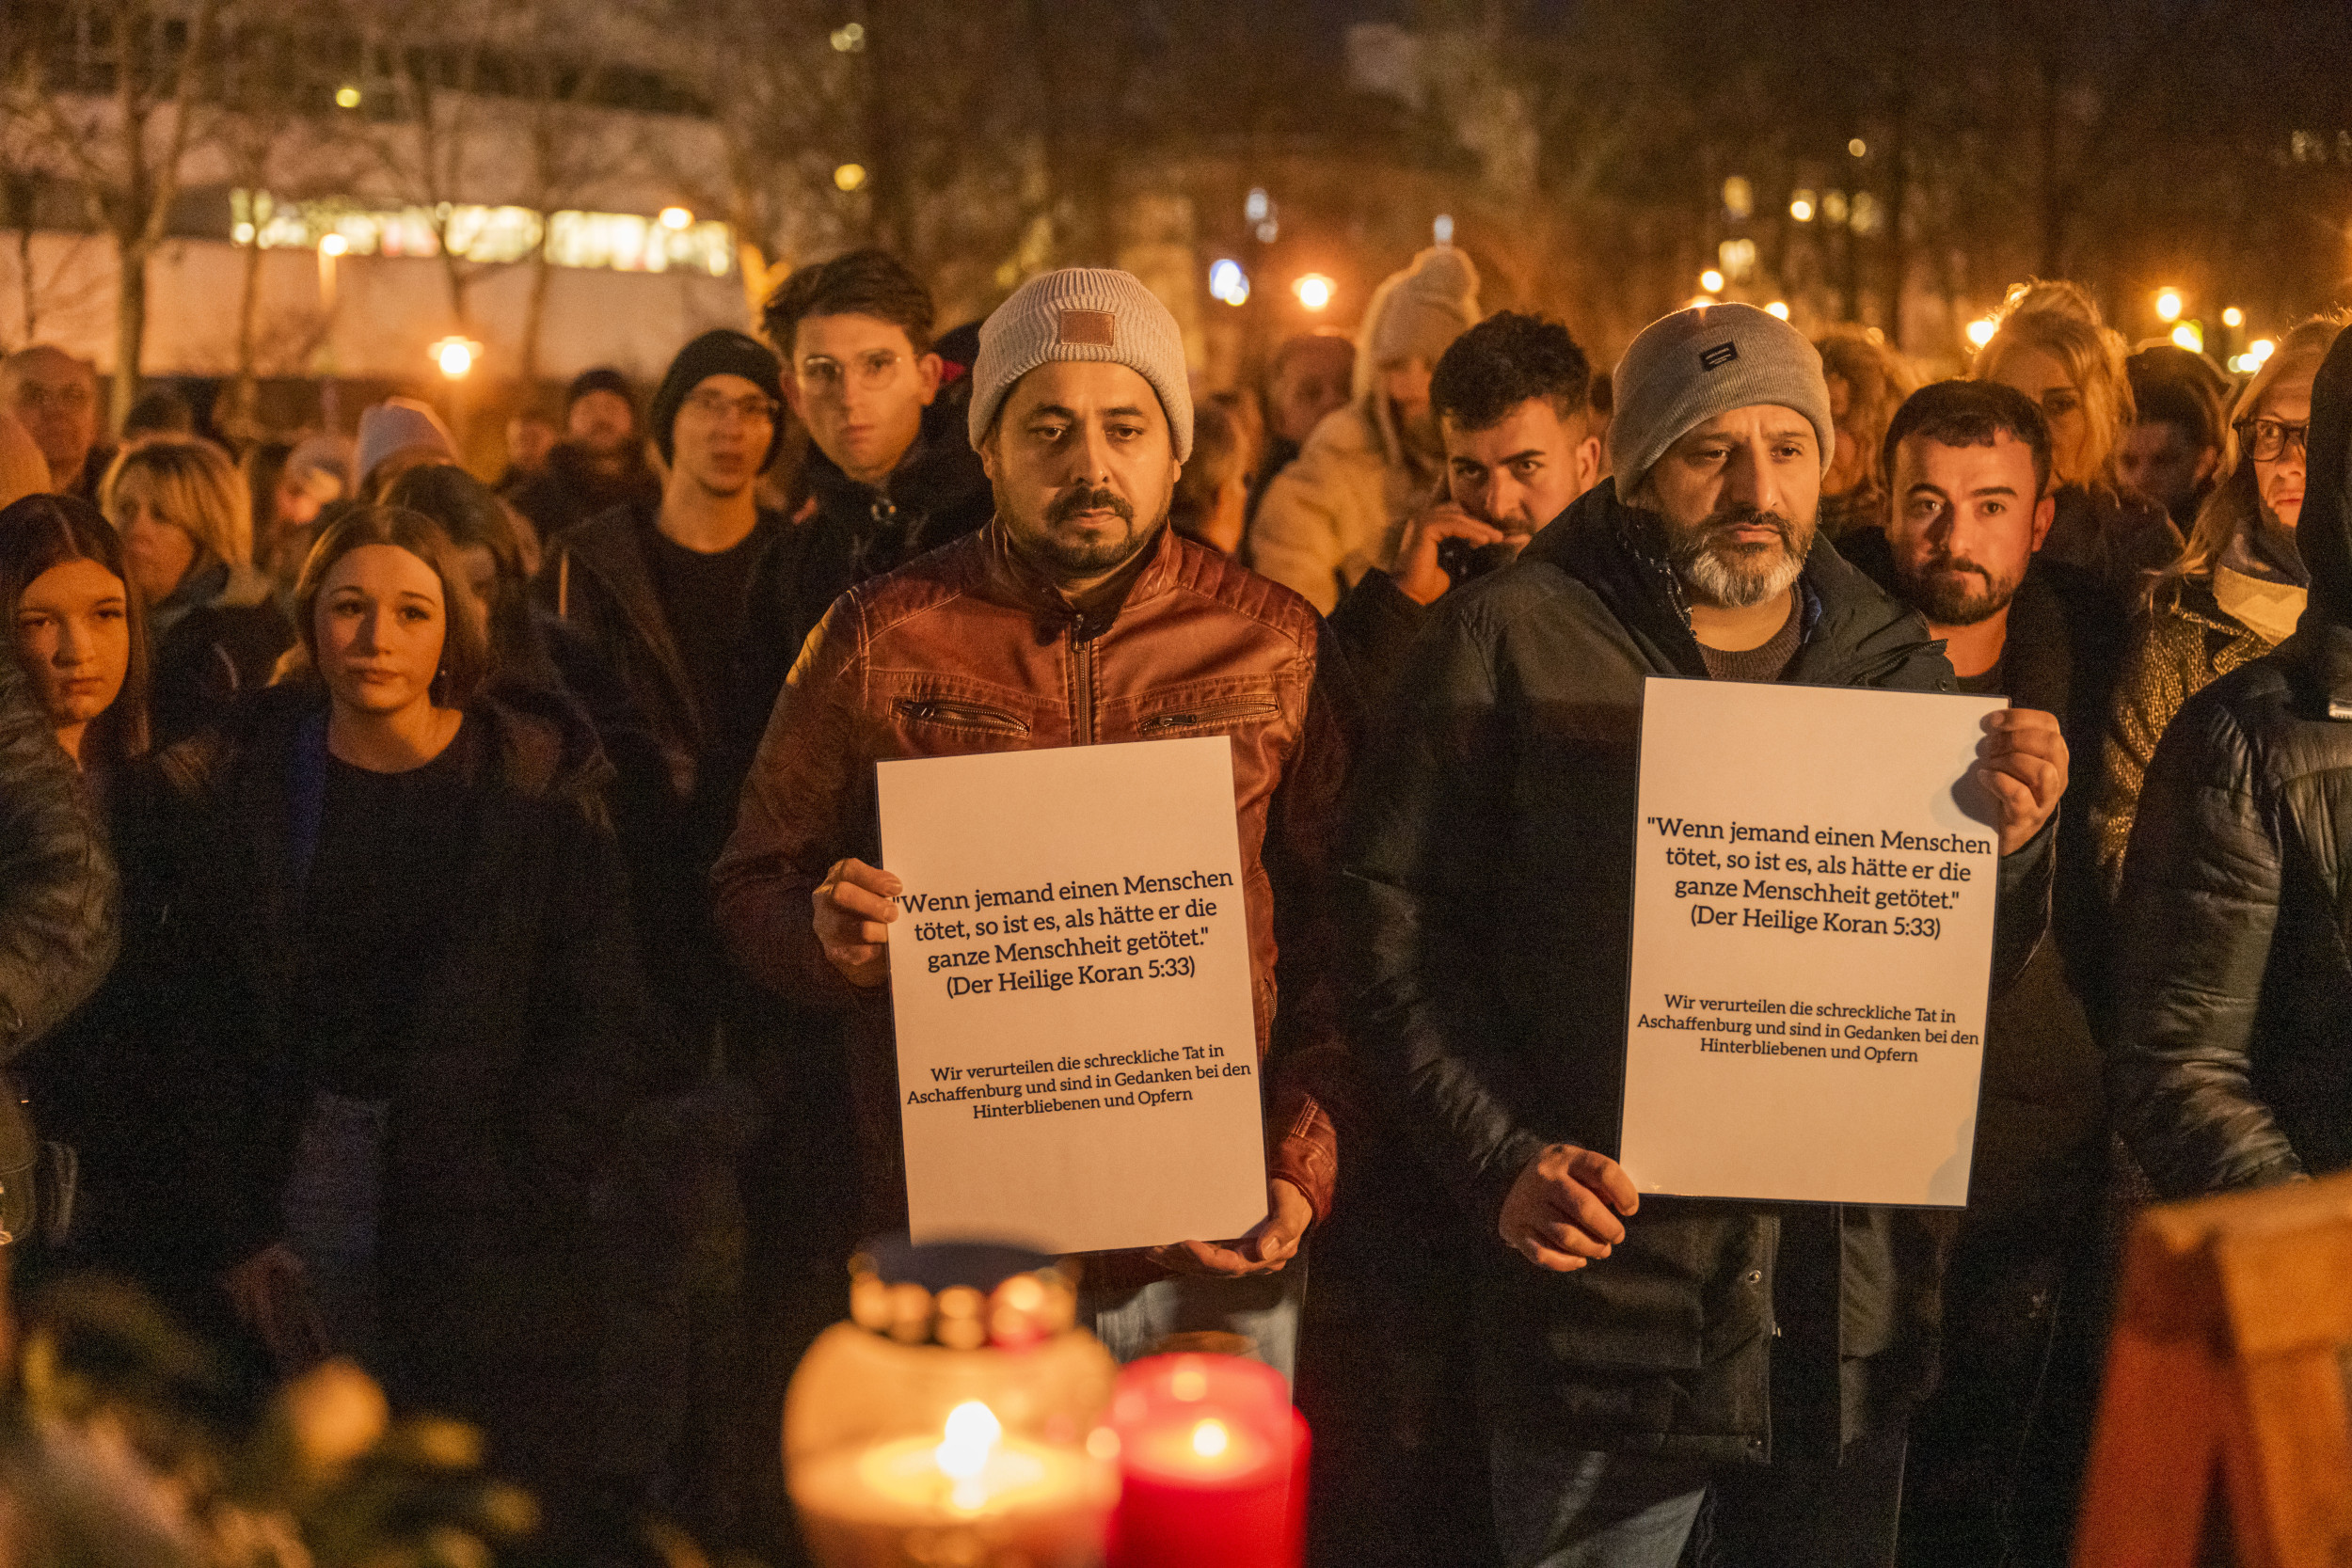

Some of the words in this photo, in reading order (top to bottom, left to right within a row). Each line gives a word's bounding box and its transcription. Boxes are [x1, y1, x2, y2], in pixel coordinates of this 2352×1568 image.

[1646, 816, 1725, 840] "Wenn
[1728, 820, 1810, 845] jemand
[1814, 826, 1875, 848] einen
[1880, 830, 1992, 855] Menschen
[1665, 847, 1722, 871] tötet,
[1726, 854, 1751, 869] so
[1754, 850, 1781, 872] ist
[1785, 857, 1812, 876] es,
[1817, 854, 1847, 875] als
[1851, 855, 1908, 879] hätte
[1912, 864, 1935, 880] er
[1938, 861, 1972, 882] die
[891, 893, 971, 914] "Wenn
[974, 881, 1056, 912] jemand
[1058, 880, 1120, 901] einen
[1122, 869, 1234, 895] Menschen
[1674, 879, 1739, 899] ganze
[1741, 879, 1871, 906] Menschheit
[1874, 888, 1960, 911] getötet."
[914, 920, 971, 942] tötet,
[975, 921, 999, 937] so
[1002, 914, 1029, 934] ist
[1033, 915, 1061, 933] es,
[1065, 908, 1095, 929] als
[1097, 904, 1154, 927] hätte
[1158, 904, 1181, 921] er
[1184, 897, 1217, 918] die
[1691, 903, 1739, 927] (Der
[1741, 908, 1819, 935] Heilige
[1822, 911, 1888, 935] Koran
[1892, 916, 1941, 942] 5:33)
[928, 950, 991, 974] ganze
[993, 934, 1122, 964] Menschheit
[1126, 926, 1209, 957] getötet."
[946, 975, 993, 1000] (Der
[997, 968, 1074, 992] Heilige
[1077, 964, 1144, 985] Koran
[1148, 955, 1196, 979] 5:33)
[1663, 993, 1696, 1010] Wir
[1698, 998, 1787, 1015] verurteilen
[1789, 1000, 1814, 1016] die
[1816, 1003, 1912, 1022] schreckliche
[1915, 1007, 1938, 1023] Tat
[1940, 1008, 1956, 1023] in
[1636, 1013, 1753, 1037] Aschaffenburg
[1755, 1021, 1787, 1036] und
[1788, 1022, 1822, 1037] sind
[1824, 1023, 1841, 1038] in
[1843, 1024, 1921, 1043] Gedanken
[1924, 1028, 1947, 1044] bei
[1950, 1029, 1979, 1046] den
[930, 1066, 963, 1083] Wir
[965, 1059, 1055, 1079] verurteilen
[1057, 1056, 1081, 1071] die
[1084, 1048, 1180, 1069] schreckliche
[1182, 1045, 1206, 1060] Tat
[1208, 1043, 1225, 1058] in
[1700, 1037, 1828, 1058] Hinterbliebenen
[1830, 1045, 1861, 1060] und
[1864, 1046, 1918, 1064] Opfern
[906, 1083, 1024, 1105] Aschaffenburg
[1025, 1078, 1057, 1095] und
[1059, 1074, 1093, 1092] sind
[1095, 1074, 1112, 1089] in
[1114, 1068, 1193, 1086] Gedanken
[1194, 1064, 1220, 1080] bei
[1221, 1062, 1252, 1078] den
[972, 1098, 1102, 1119] Hinterbliebenen
[1103, 1091, 1136, 1108] und
[1137, 1088, 1194, 1107] Opfern
